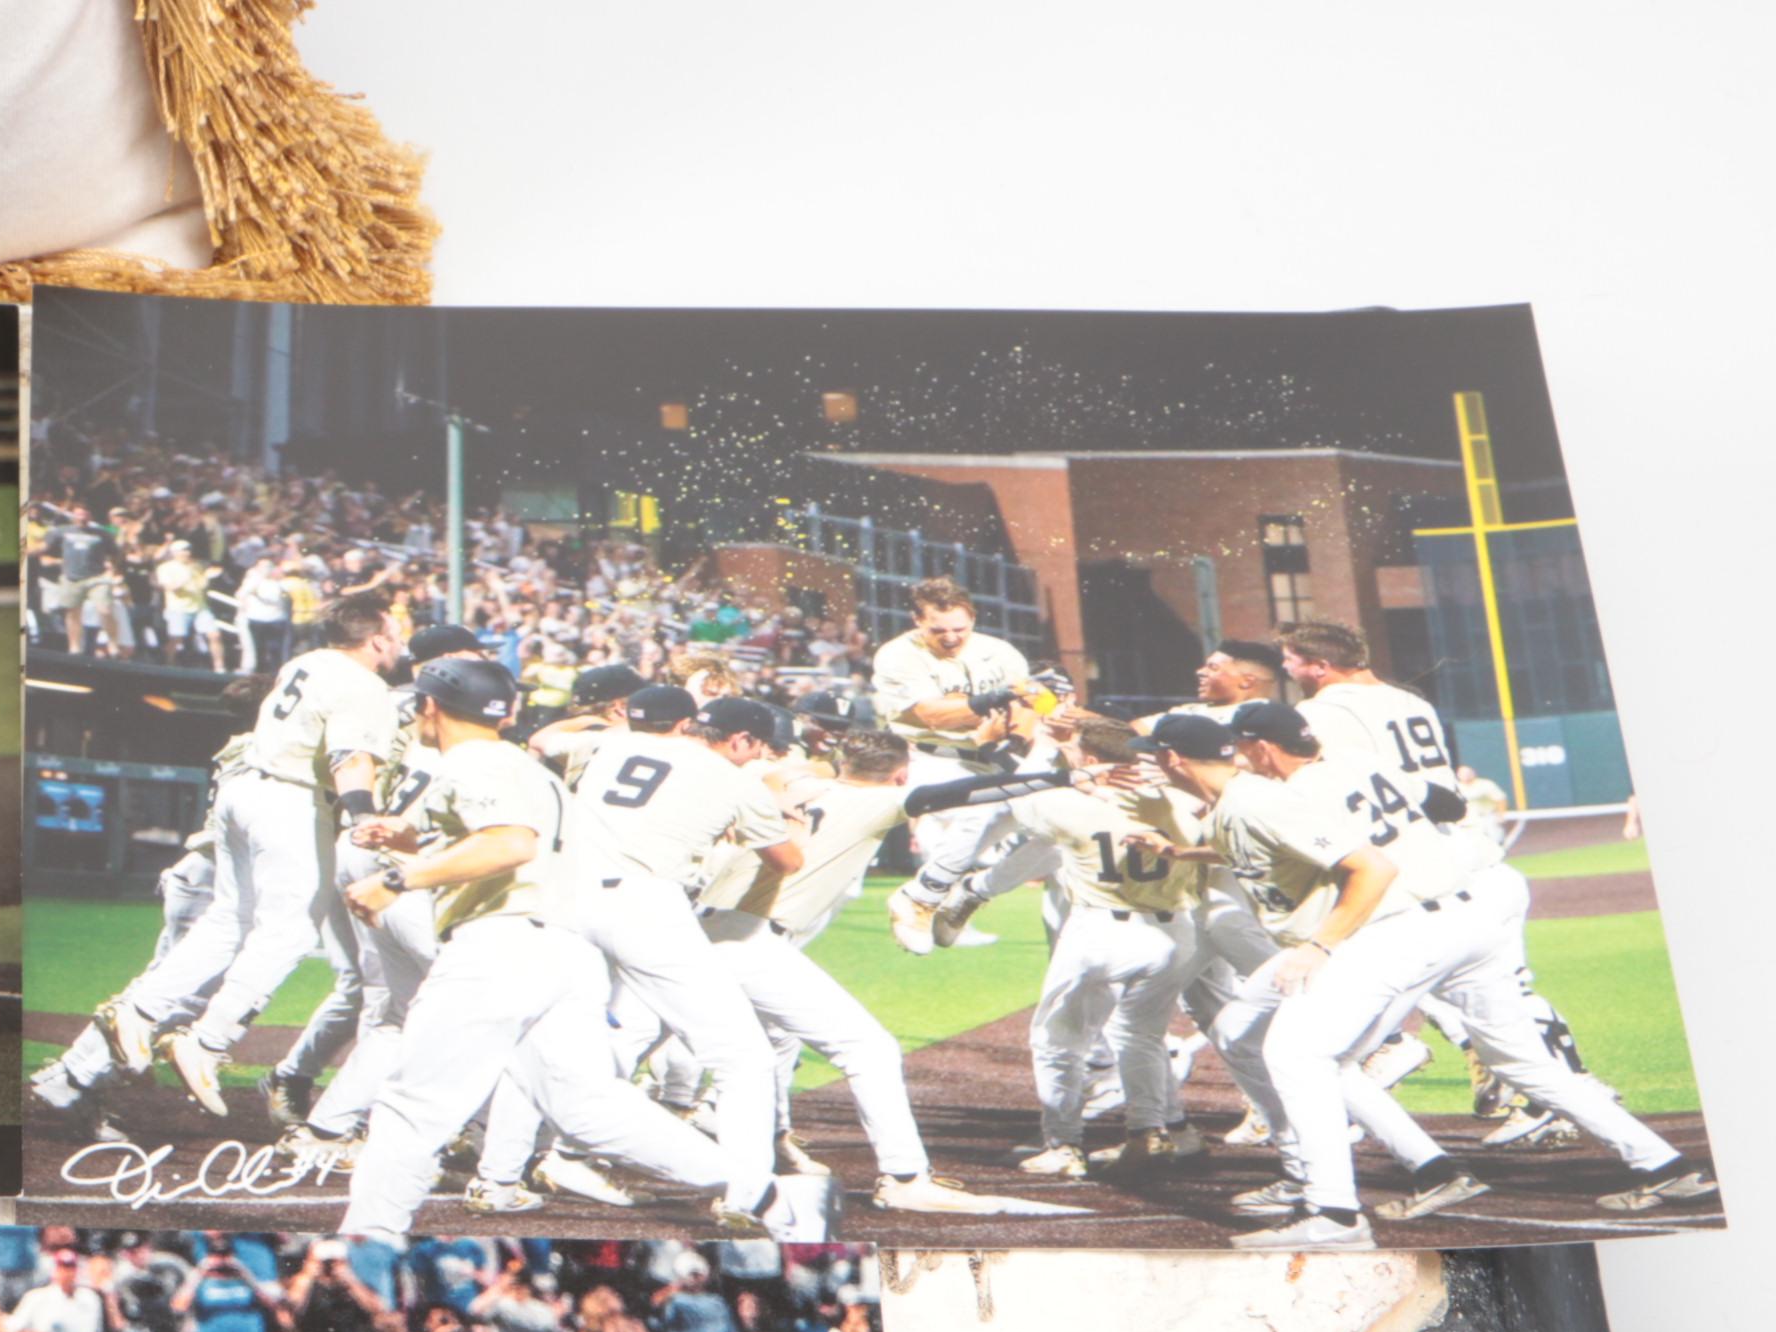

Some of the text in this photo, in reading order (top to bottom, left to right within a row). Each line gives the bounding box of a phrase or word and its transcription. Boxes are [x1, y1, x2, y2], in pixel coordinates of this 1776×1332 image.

[273, 668, 309, 720] 5
[1386, 716, 1447, 773] 19
[602, 754, 673, 809] 9
[1345, 772, 1424, 847] 34
